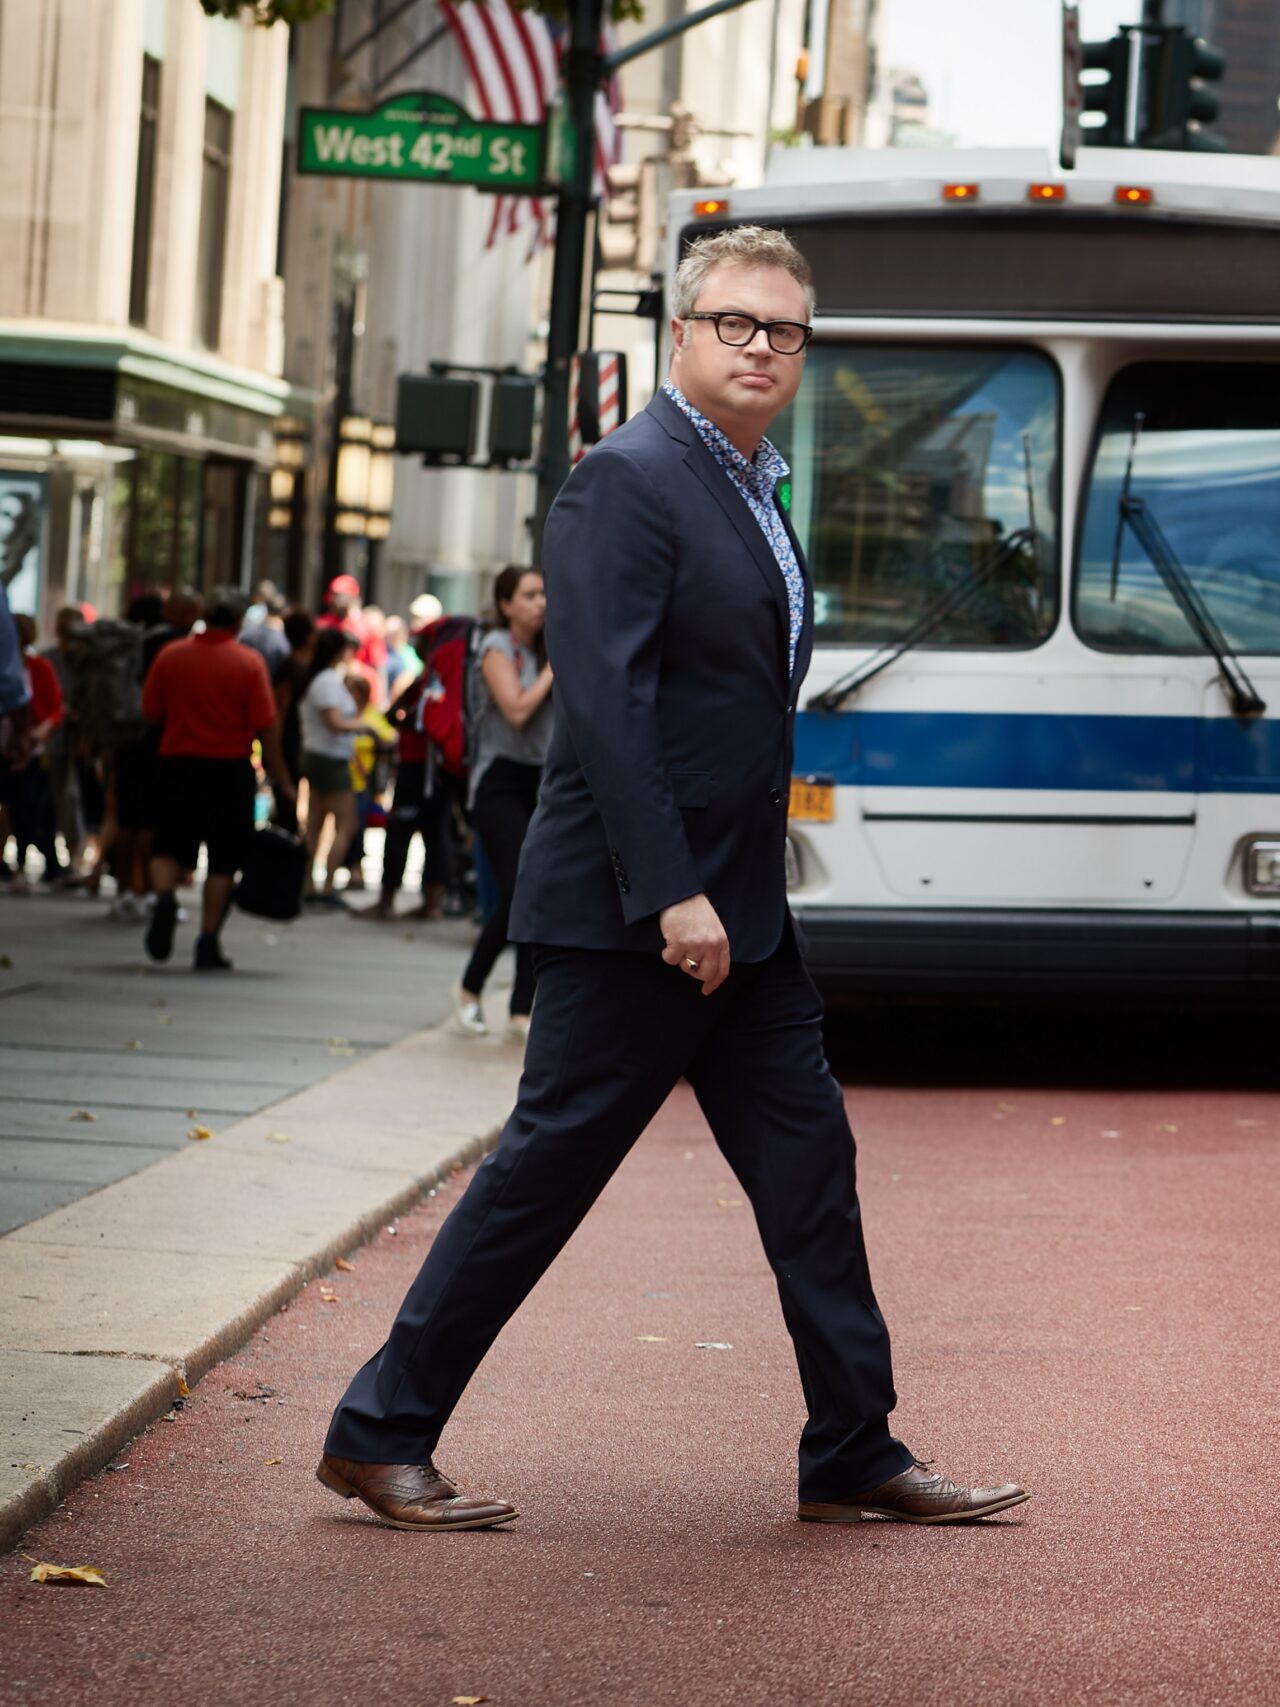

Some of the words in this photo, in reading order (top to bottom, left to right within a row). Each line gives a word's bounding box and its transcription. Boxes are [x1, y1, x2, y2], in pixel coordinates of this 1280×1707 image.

[313, 124, 405, 168] West
[409, 131, 483, 171] 42nd
[488, 136, 527, 175] St
